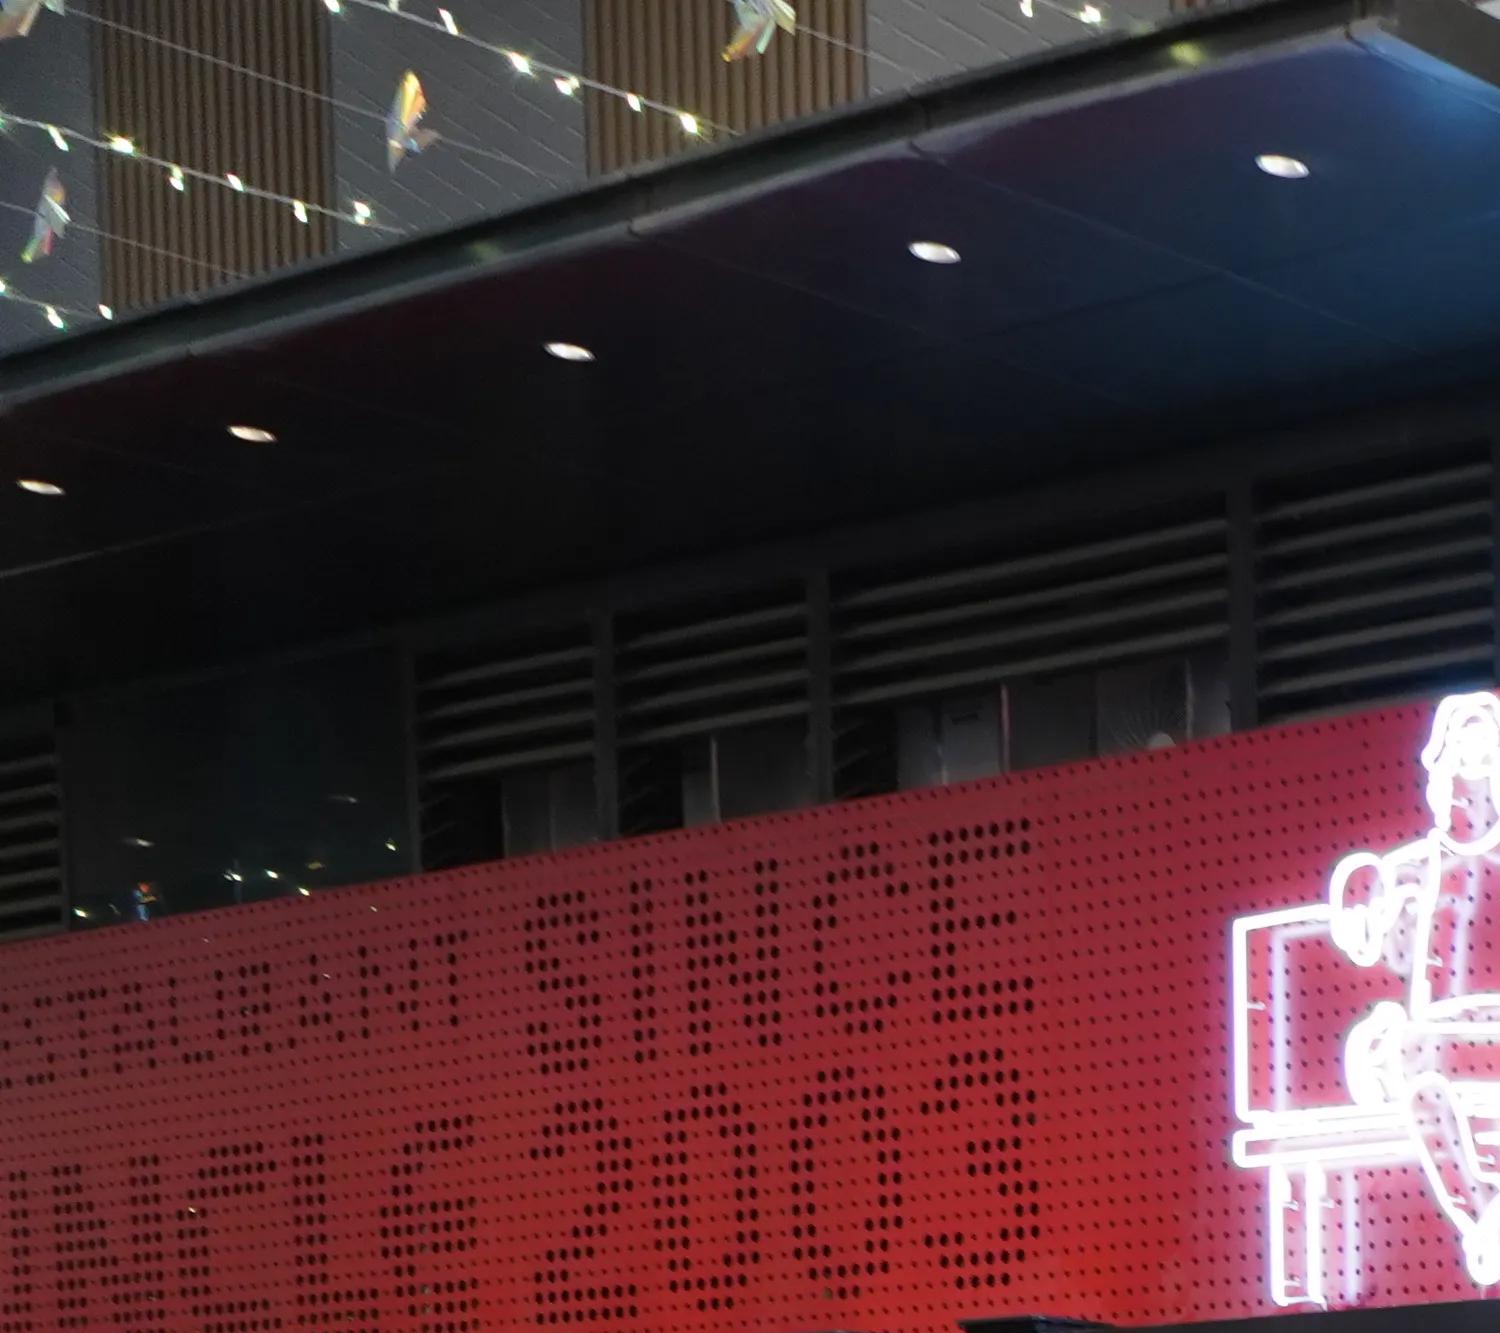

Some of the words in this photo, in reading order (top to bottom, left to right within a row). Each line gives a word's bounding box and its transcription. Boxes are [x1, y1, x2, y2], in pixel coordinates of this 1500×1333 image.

[0, 932, 467, 1090] STAURANT
[526, 818, 1033, 1073] SINCE
[528, 1046, 1037, 1322] 2003
